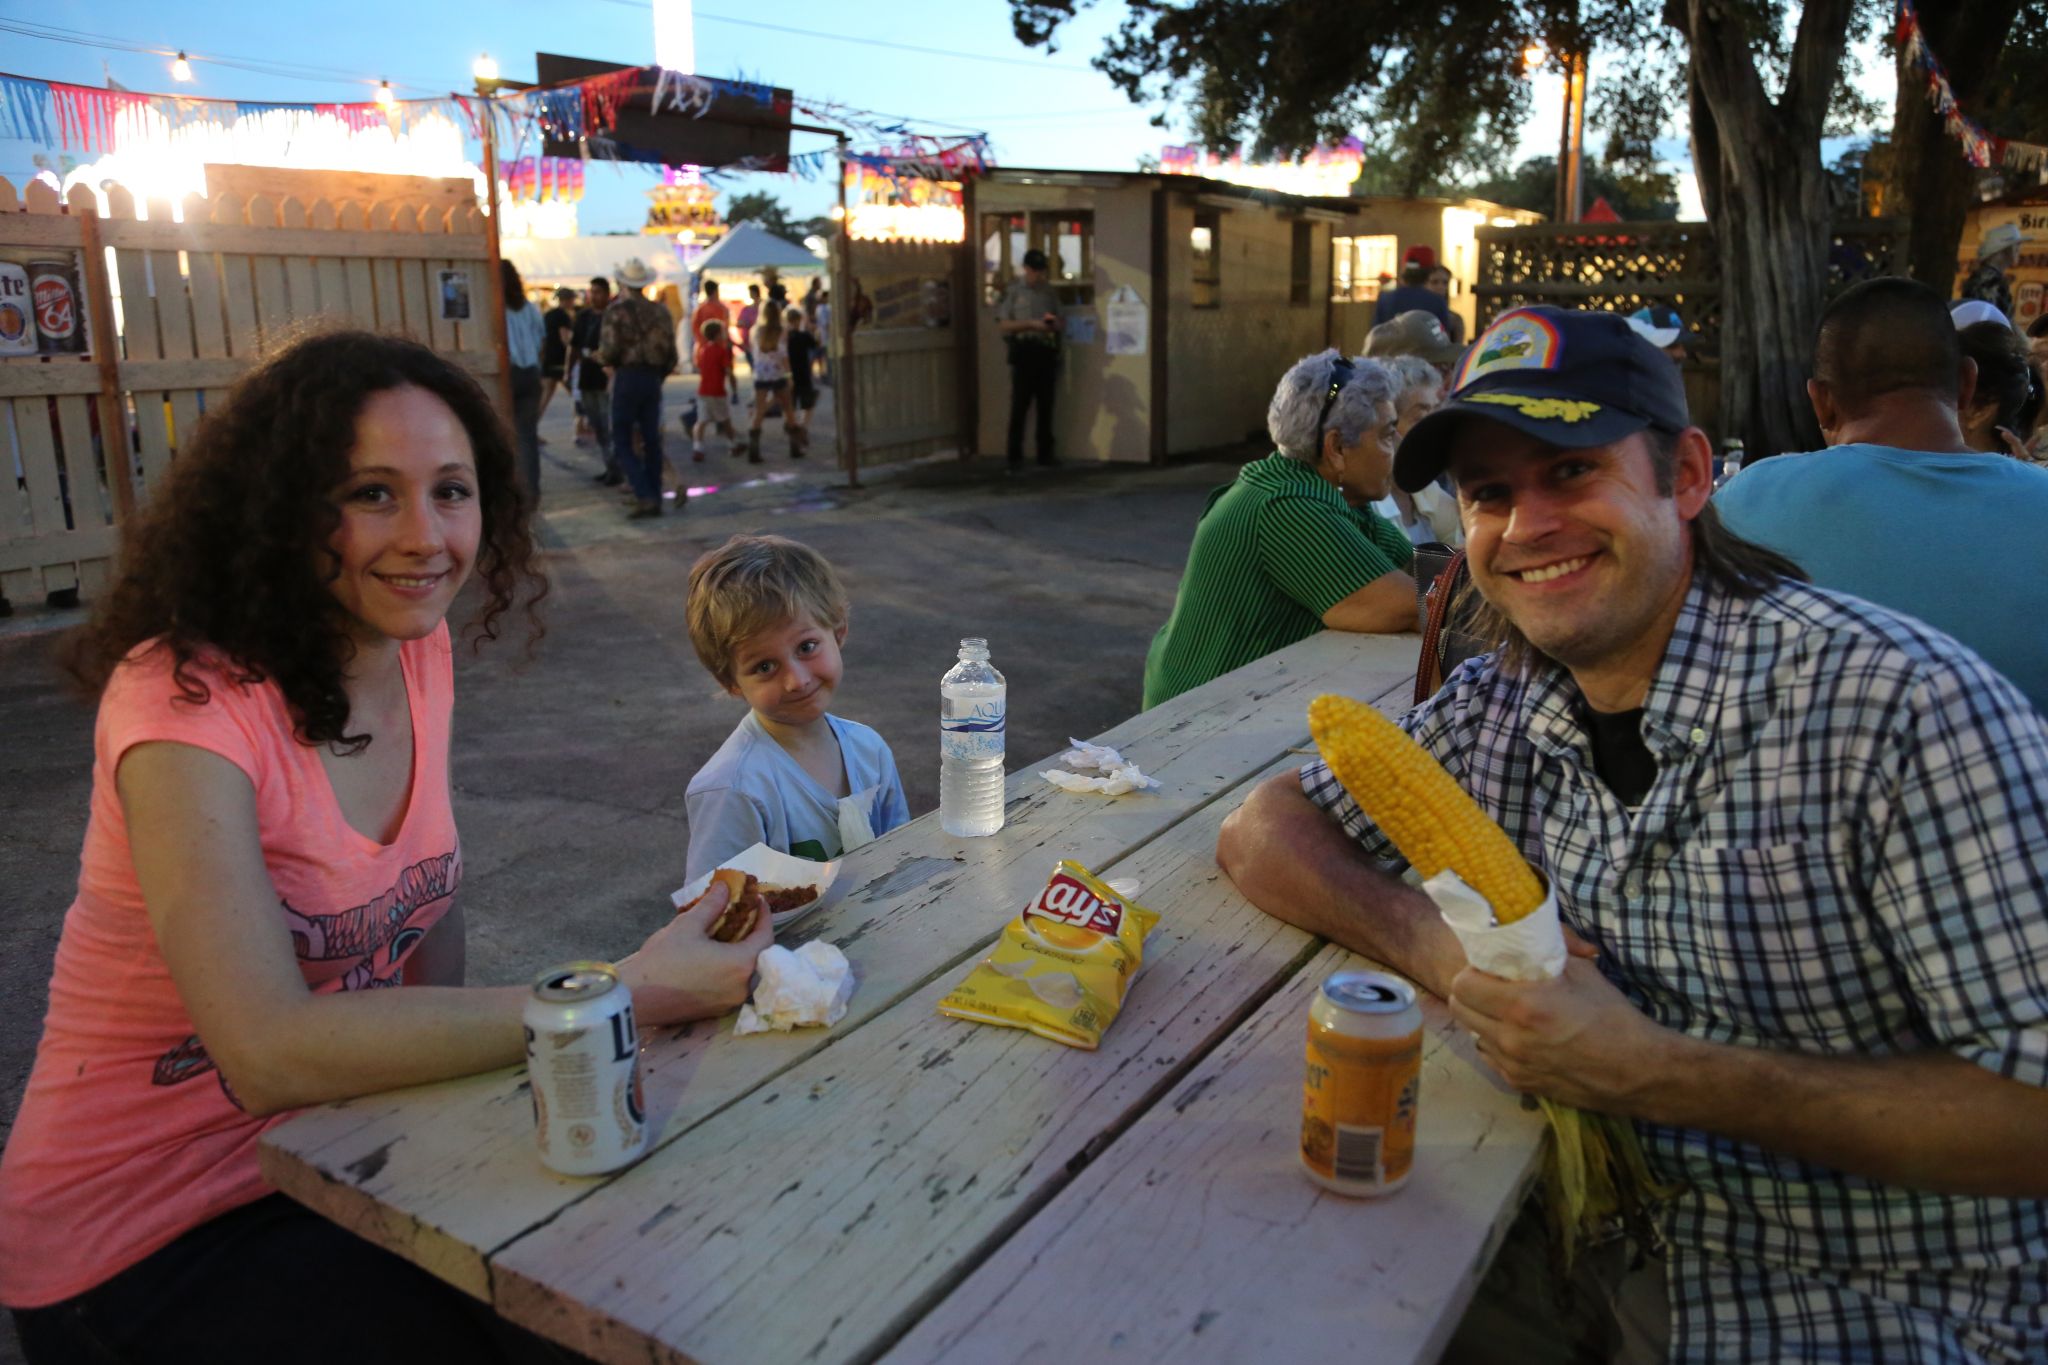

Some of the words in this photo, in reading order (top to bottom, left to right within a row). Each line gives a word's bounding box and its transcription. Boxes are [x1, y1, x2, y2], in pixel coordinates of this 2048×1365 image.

[0, 275, 24, 296] te
[44, 301, 73, 330] 64
[1027, 882, 1118, 927] Lay's
